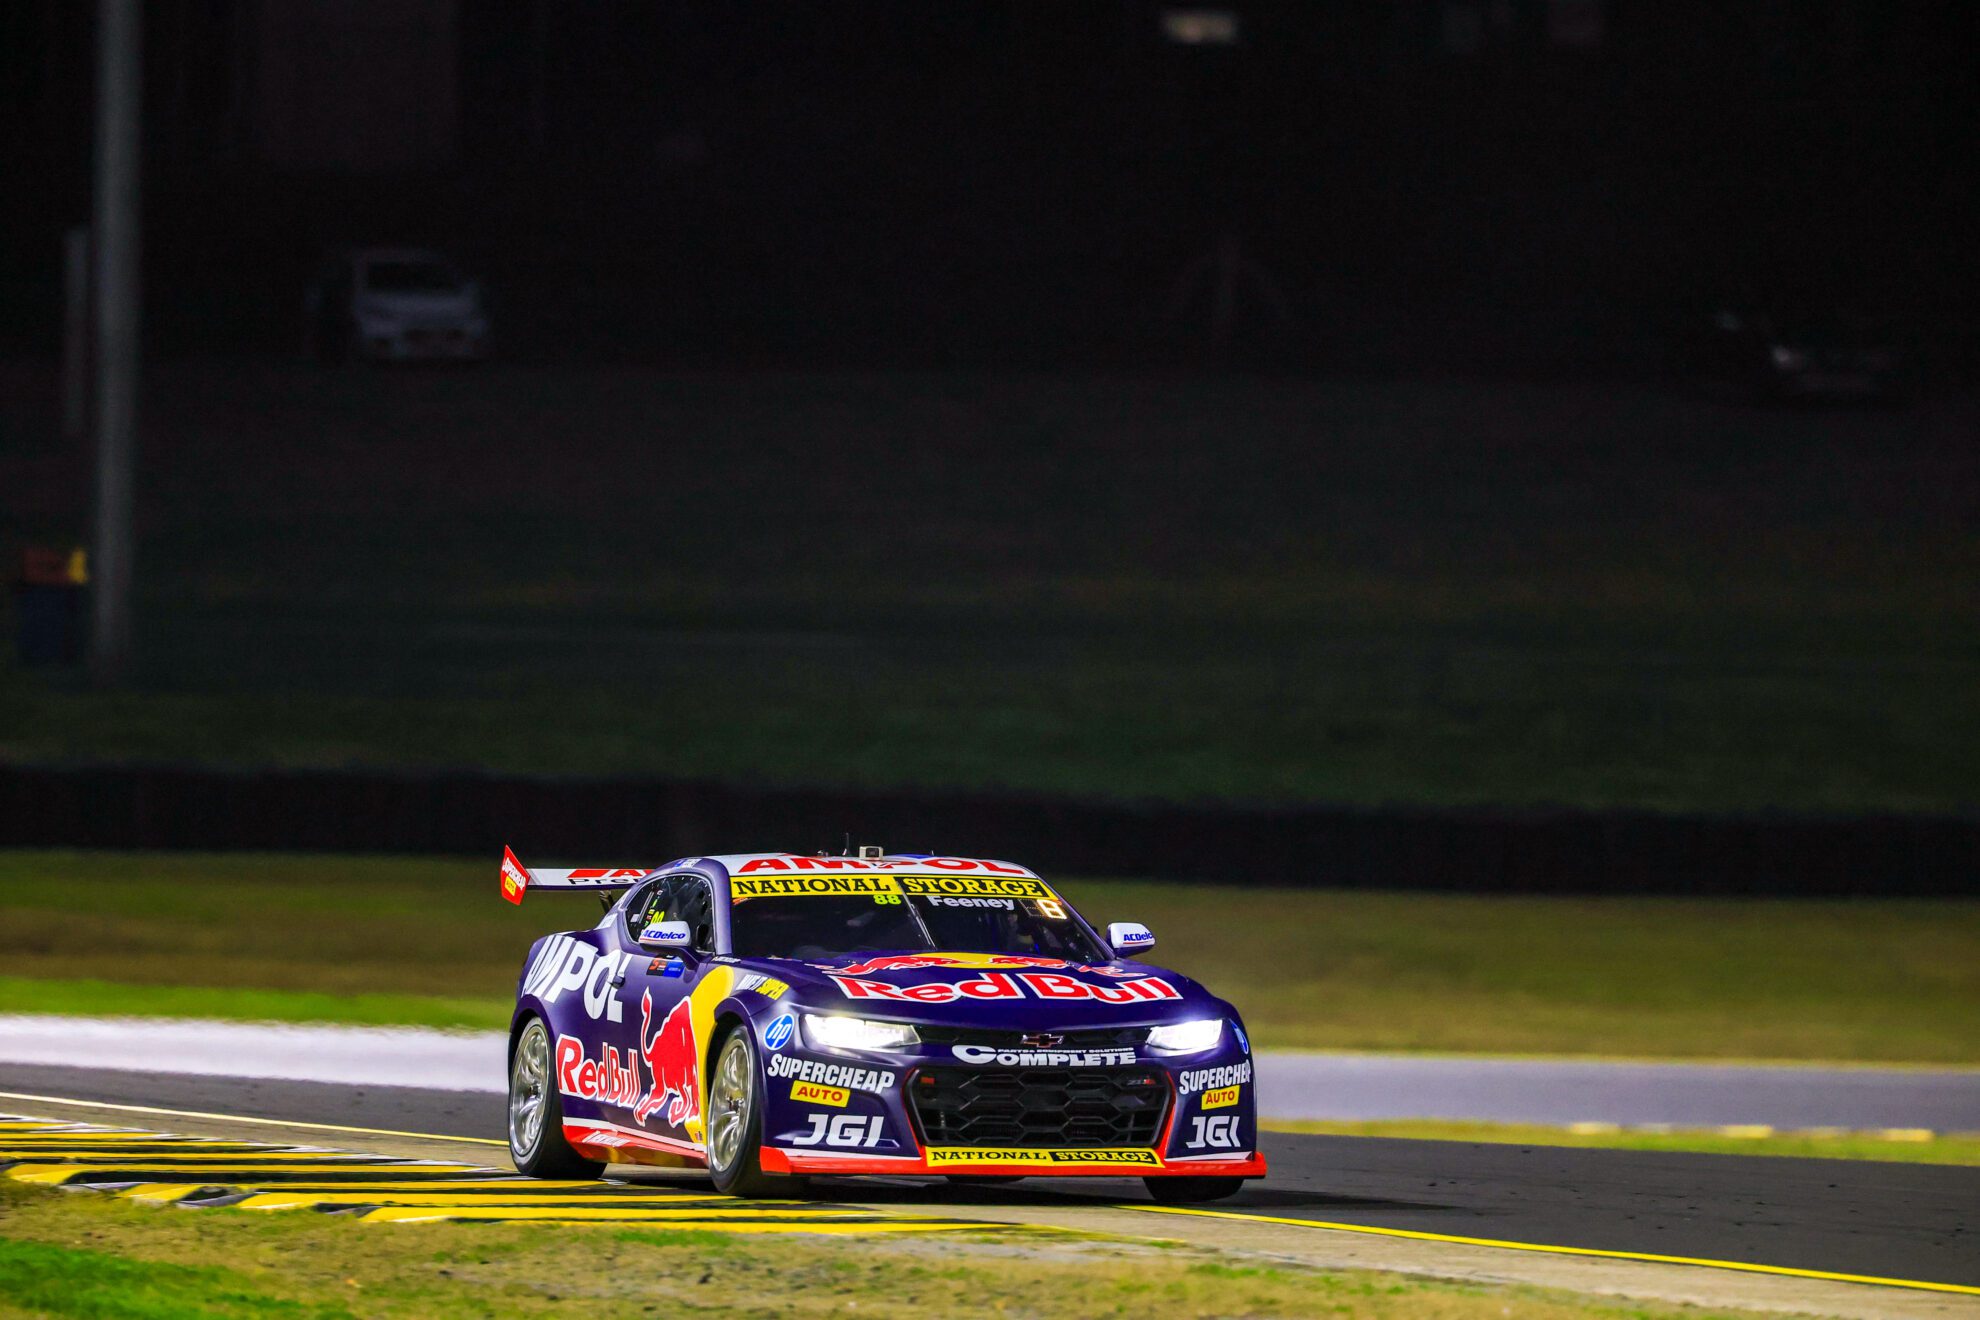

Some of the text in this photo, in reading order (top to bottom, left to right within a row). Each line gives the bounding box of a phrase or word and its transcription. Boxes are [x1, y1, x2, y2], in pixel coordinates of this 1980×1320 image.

[733, 878, 1043, 896] NATIONAL STORAGE
[873, 895, 901, 905] 88
[926, 895, 1014, 911] Feeney
[642, 929, 686, 940] ACDelco
[1123, 931, 1153, 942] ACDelc
[830, 973, 1184, 1004] Red Bull
[767, 1014, 792, 1050] hp
[952, 1045, 1137, 1066] COMPLETE
[767, 1053, 896, 1094] SUPERCHEAP
[796, 1086, 843, 1102] AUTO
[1205, 1091, 1235, 1105] AUTO
[793, 1113, 885, 1148] JGI
[1186, 1115, 1241, 1149] JGI
[932, 1151, 1152, 1162] NATIONAL STORAGE
